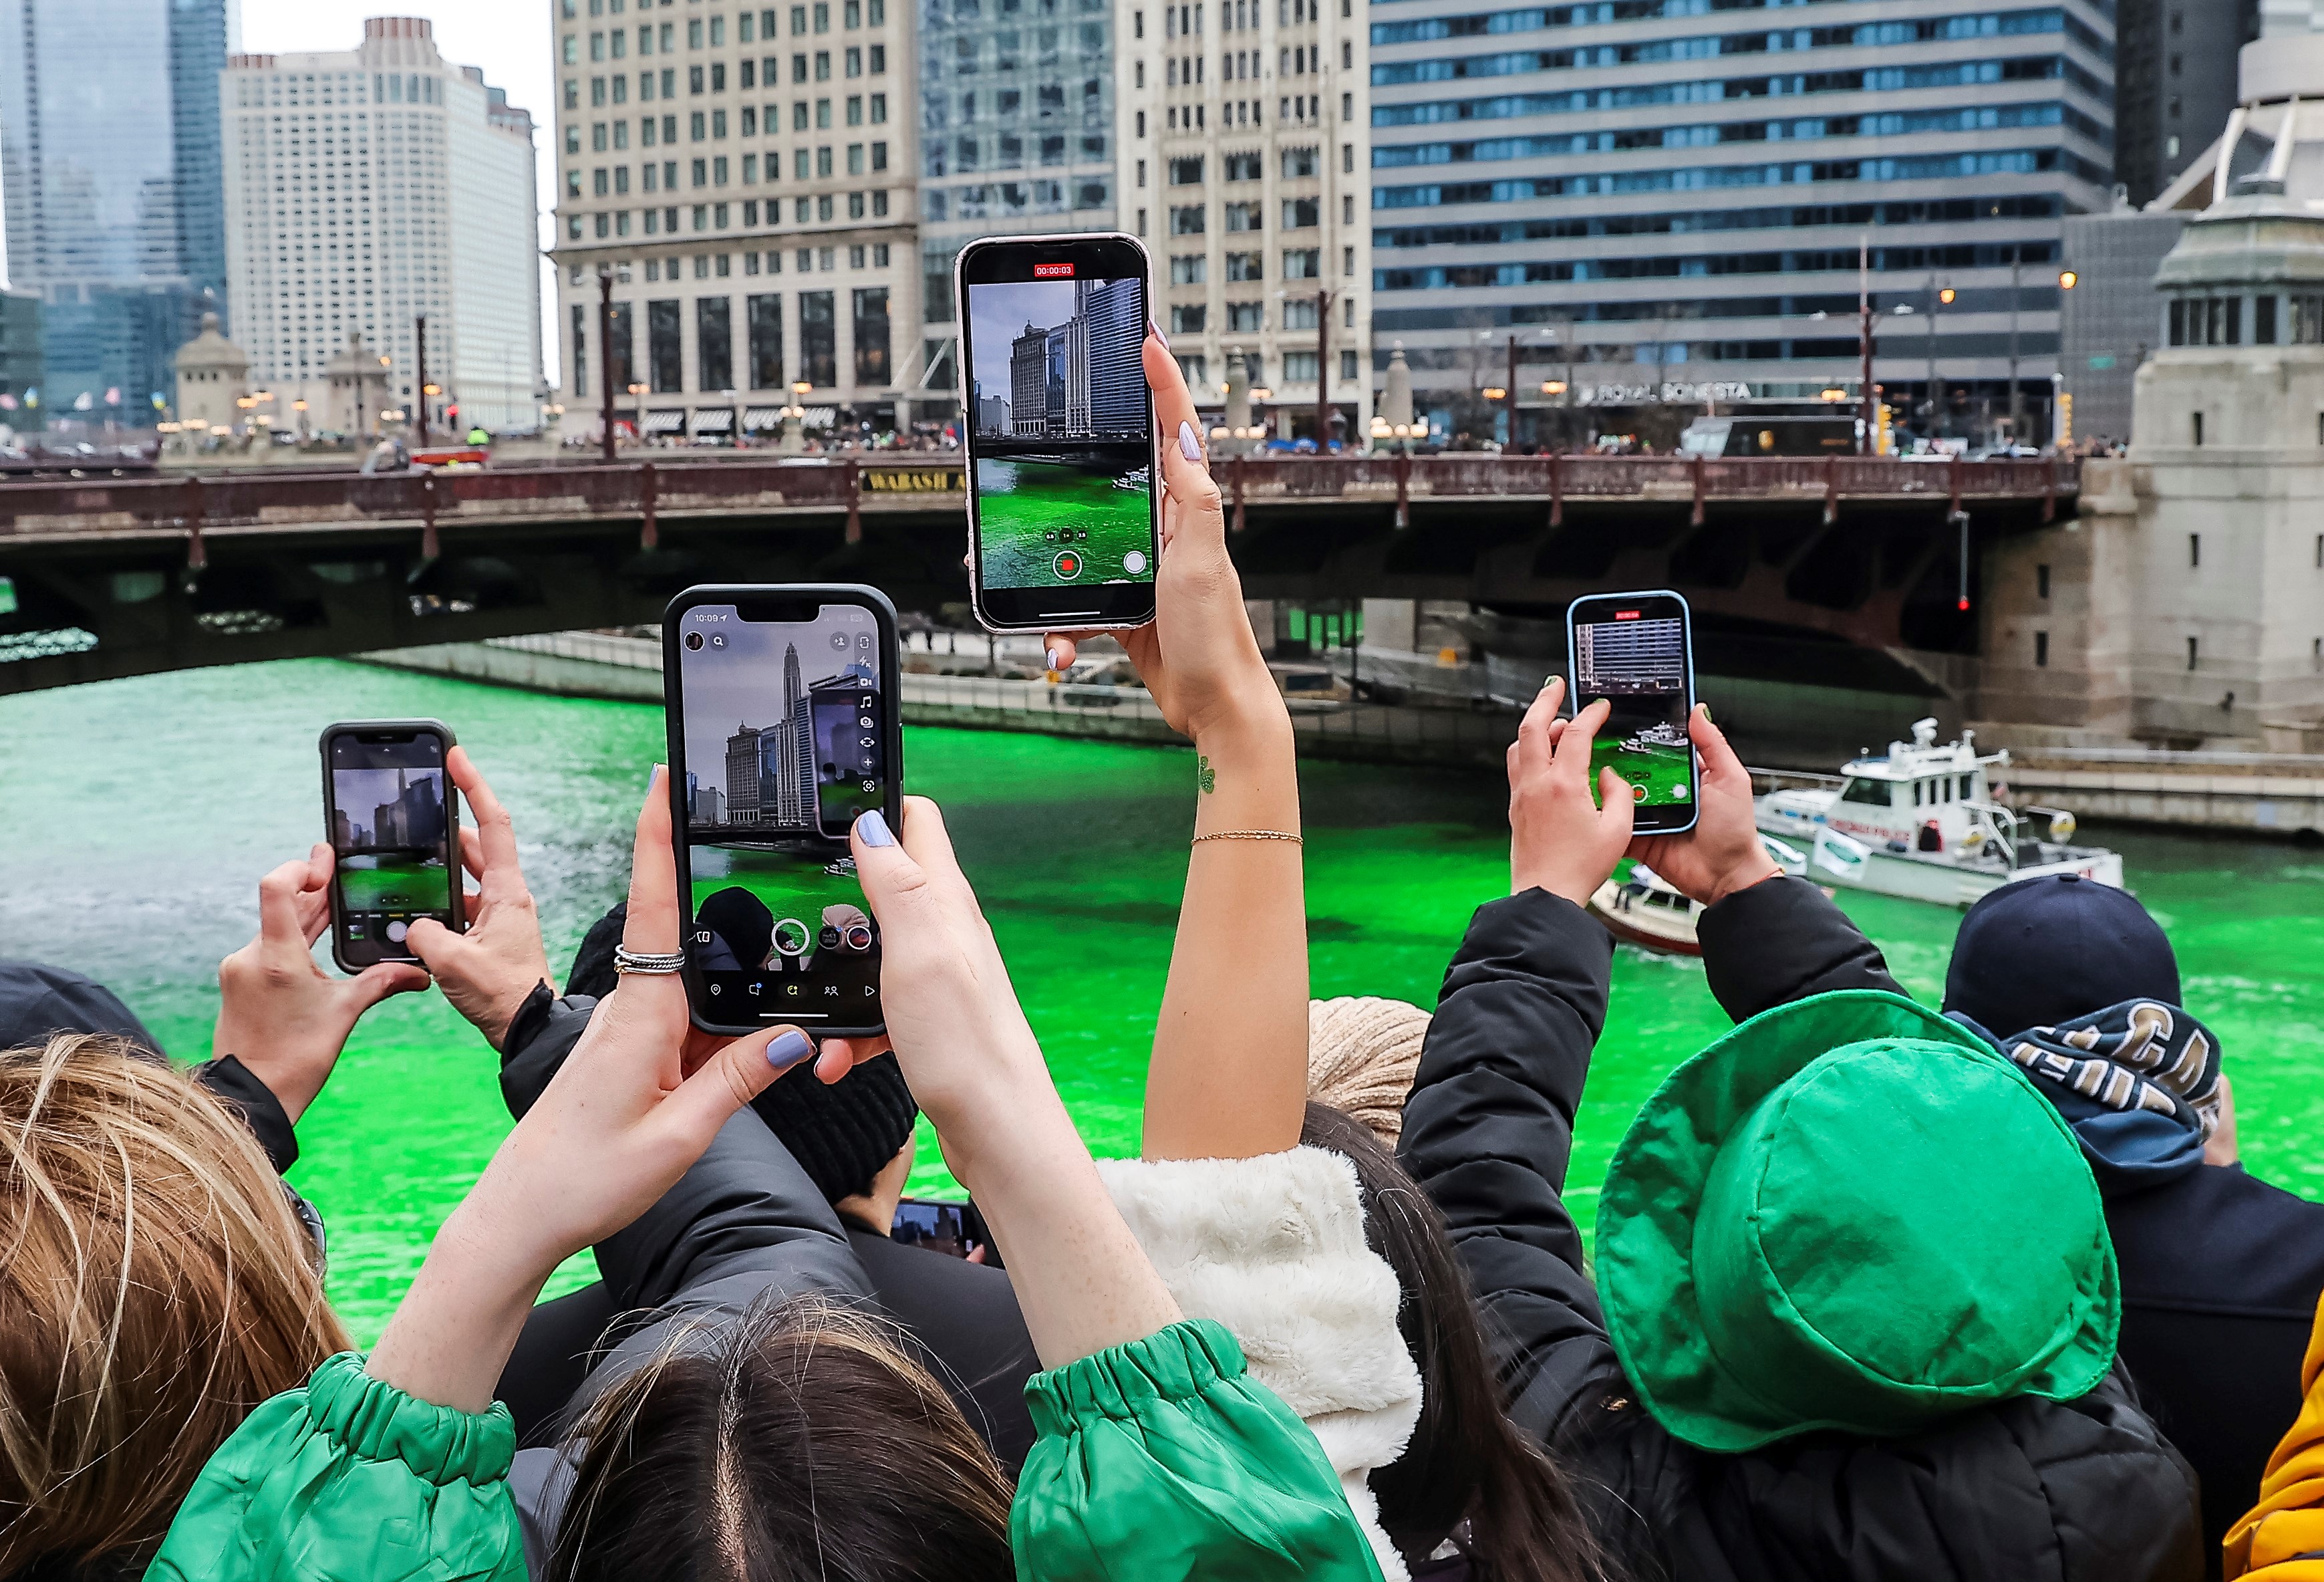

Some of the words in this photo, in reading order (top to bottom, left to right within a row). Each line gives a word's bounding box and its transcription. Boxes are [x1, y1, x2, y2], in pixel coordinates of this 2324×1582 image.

[1036, 266, 1071, 275] 00:00:03
[870, 472, 947, 490] WABASH
[695, 614, 718, 622] 10:09
